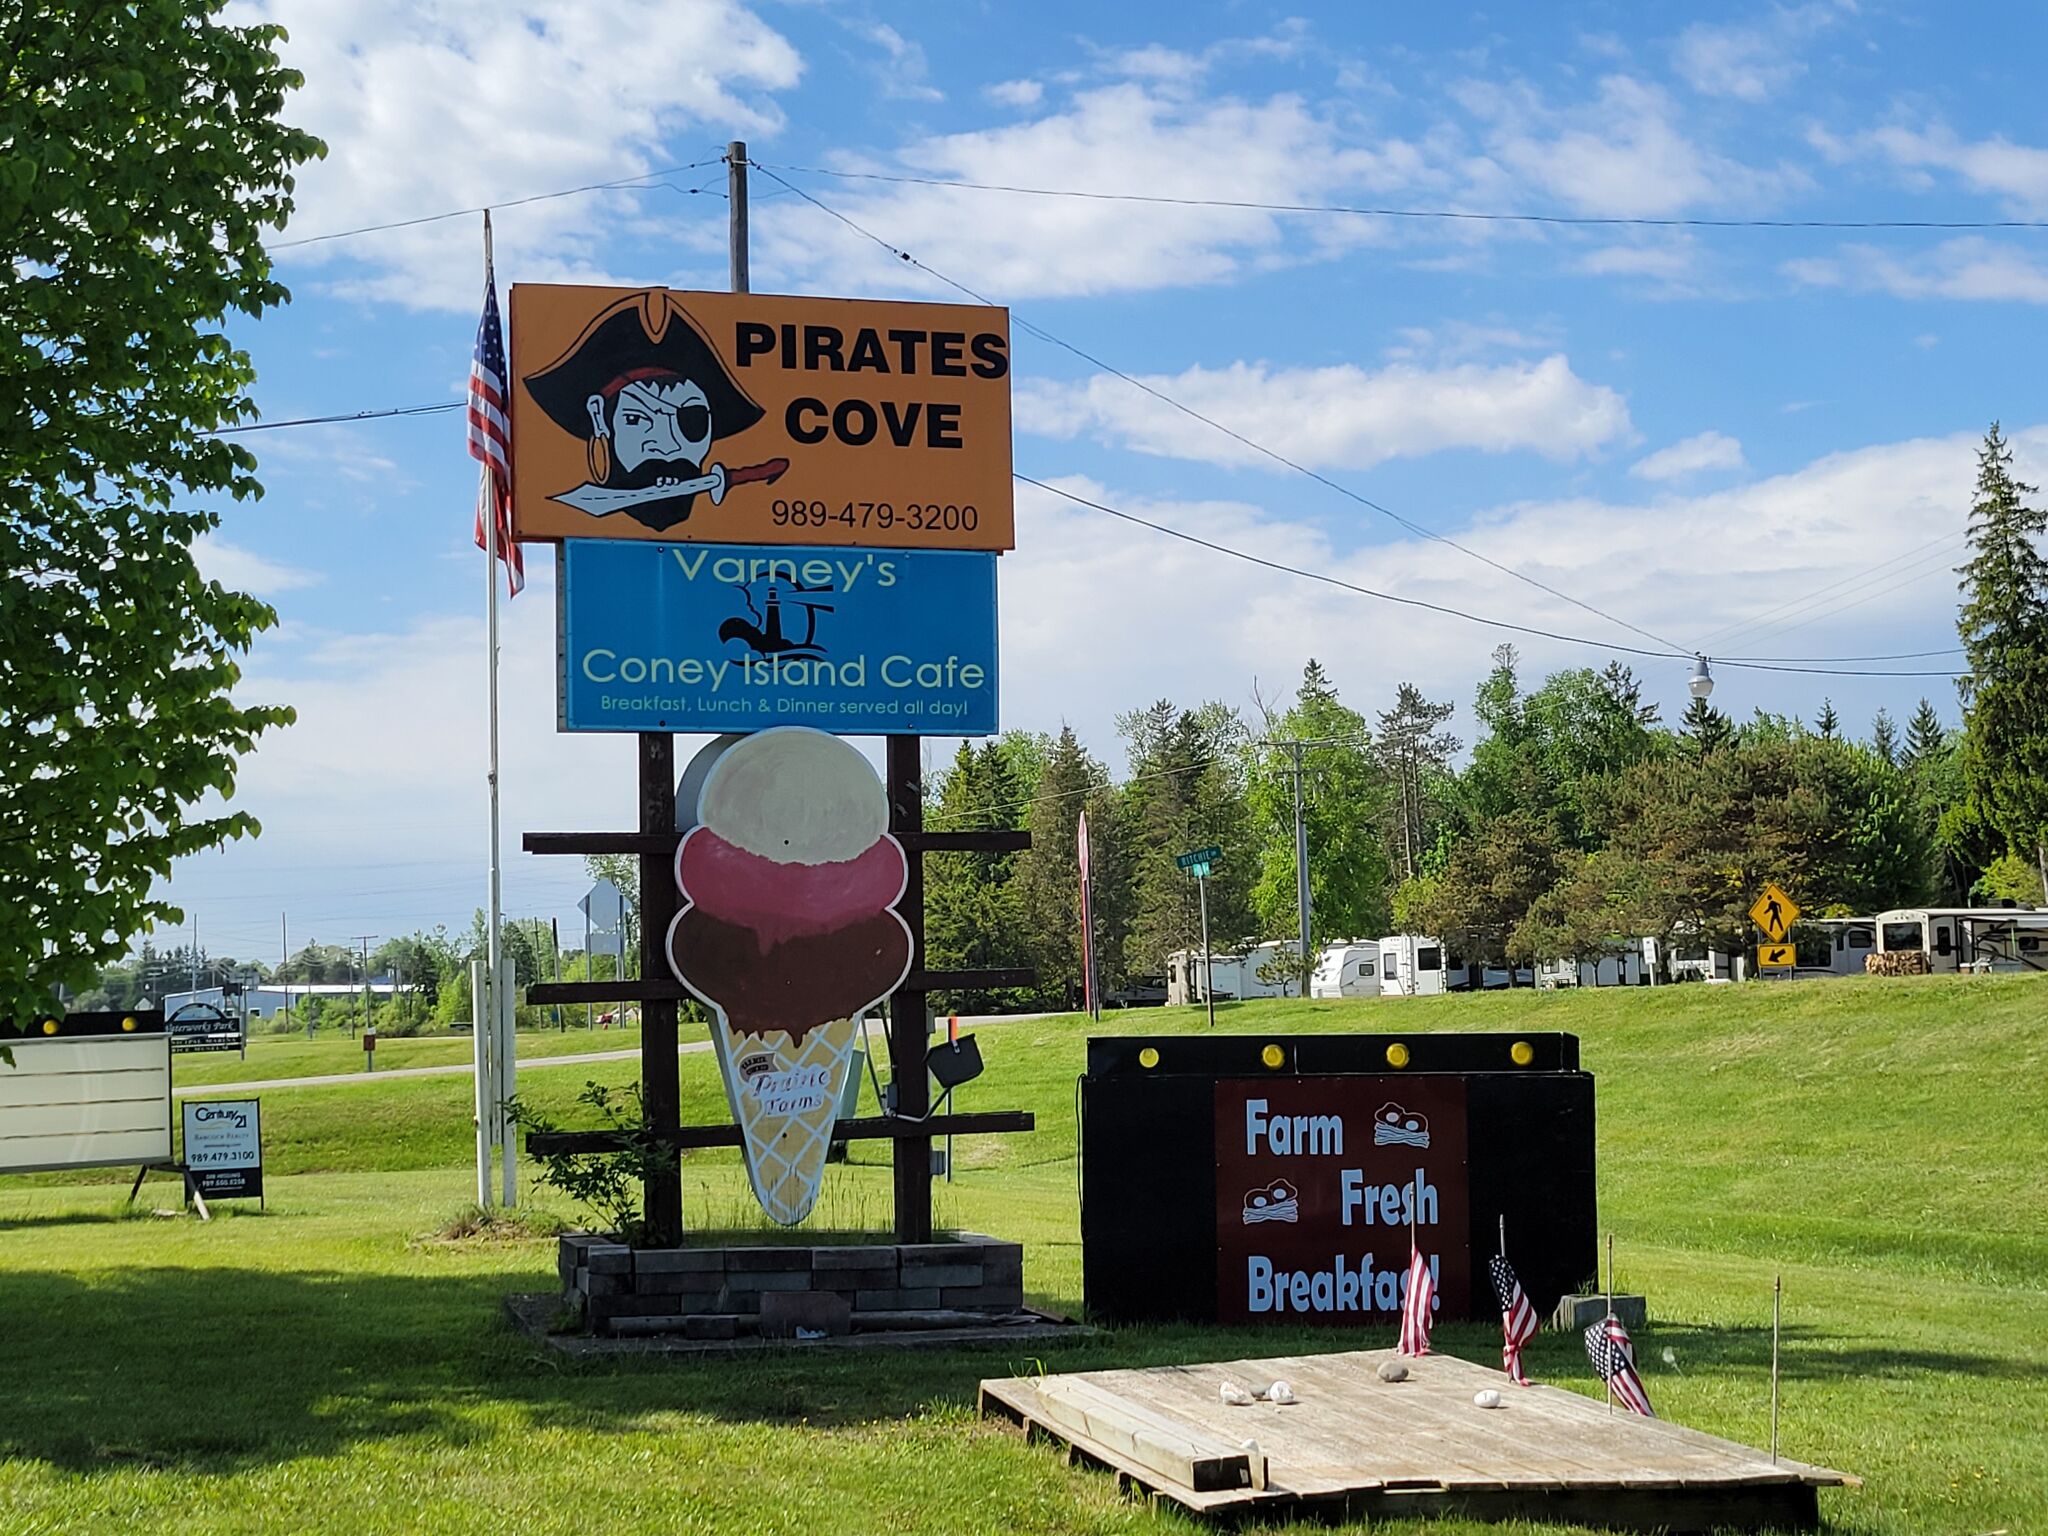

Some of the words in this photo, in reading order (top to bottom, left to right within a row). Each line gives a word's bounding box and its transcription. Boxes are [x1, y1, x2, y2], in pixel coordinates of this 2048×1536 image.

[735, 321, 1008, 379] PIRATES
[785, 398, 963, 449] COVE
[771, 500, 979, 531] 989-479-3200
[674, 549, 897, 593] Varney's
[583, 648, 730, 692] Coney
[744, 654, 866, 688] Island
[881, 654, 985, 689] Cafe
[601, 695, 692, 713] Breakfast,
[698, 696, 751, 712] Lunch
[758, 698, 771, 713] &
[777, 698, 834, 714] Dinner
[840, 699, 898, 715] served
[904, 699, 924, 715] all
[929, 699, 968, 718] day!
[213, 1020, 236, 1031] Park
[195, 1107, 239, 1121] Century
[235, 1115, 247, 1128] 21
[767, 1095, 822, 1115] Farms
[1246, 1099, 1343, 1155] Farm
[1341, 1168, 1438, 1226] Fresh
[1248, 1252, 1440, 1312] Breakfa!
